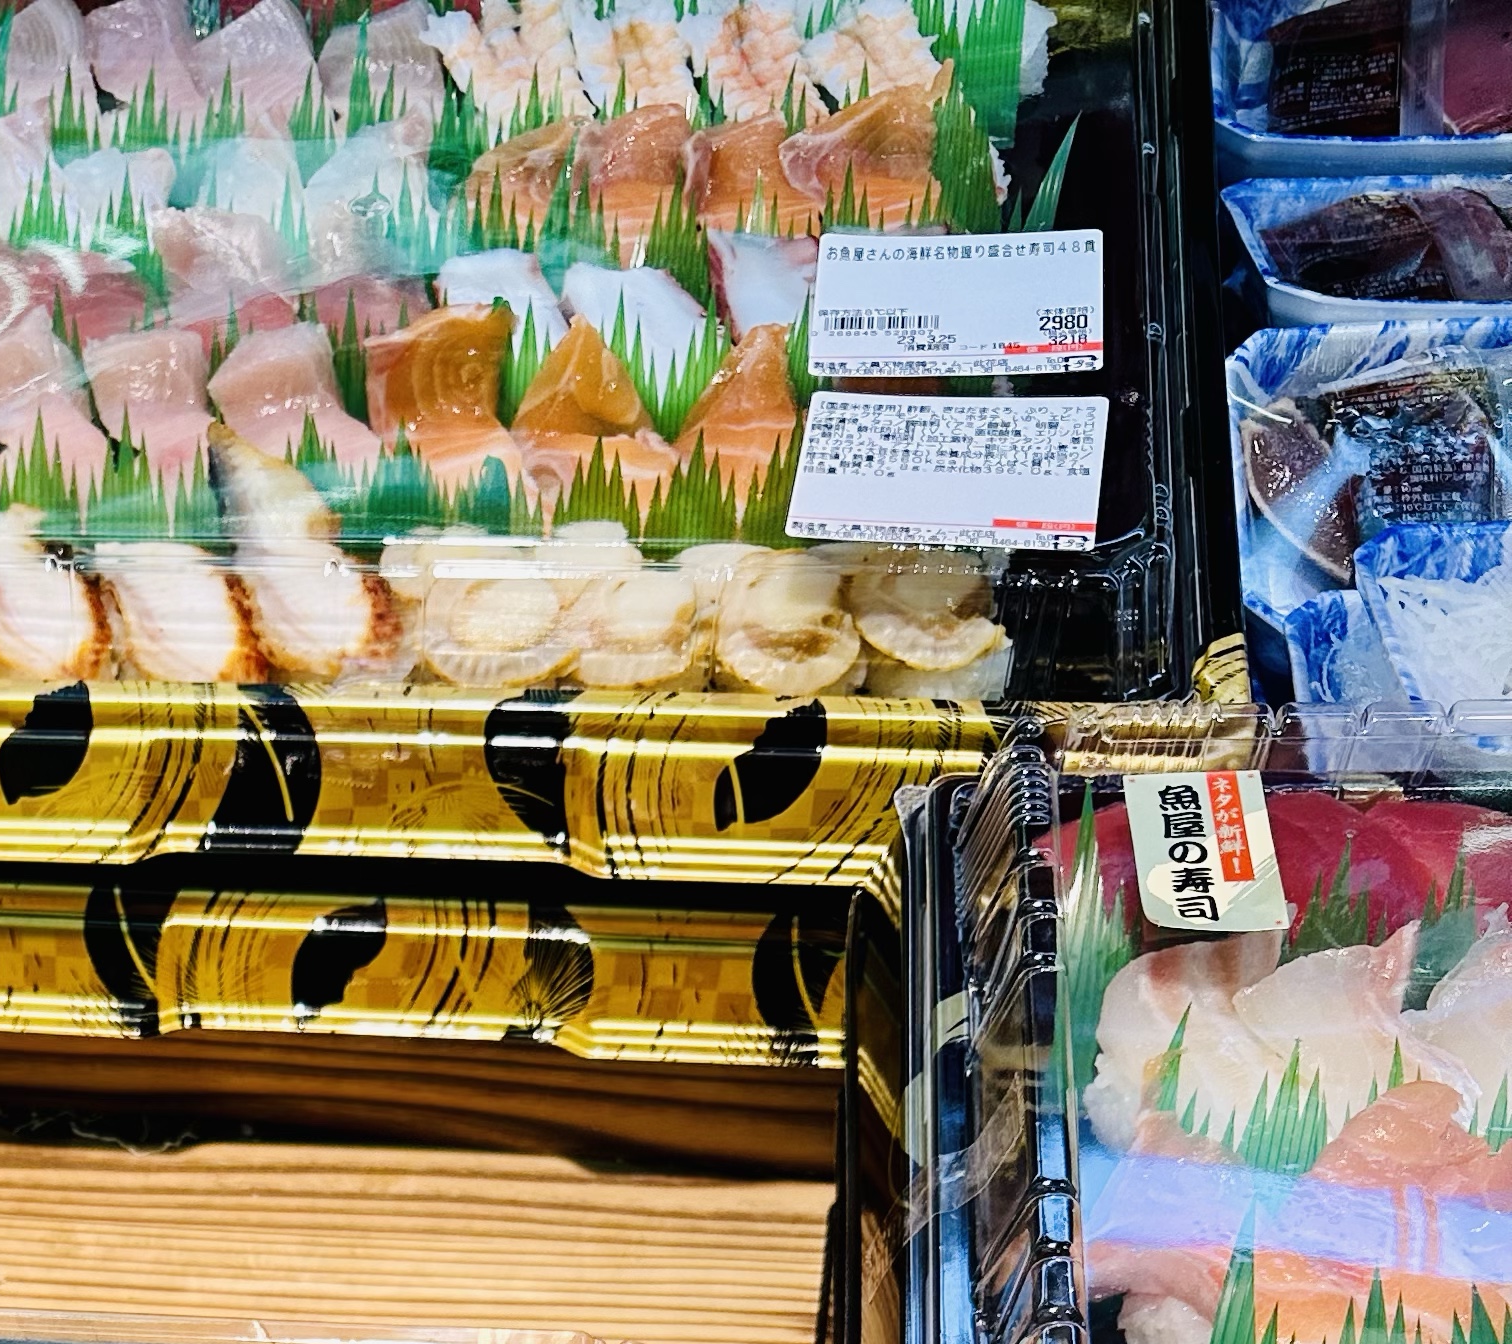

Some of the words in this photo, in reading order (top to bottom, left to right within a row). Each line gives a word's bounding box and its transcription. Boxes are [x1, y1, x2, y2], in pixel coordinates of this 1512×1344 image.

[1040, 314, 1088, 331] 2980
[1158, 785, 1219, 922] 魚屋の寿司
[1212, 777, 1248, 874] ネタが新鮮！
